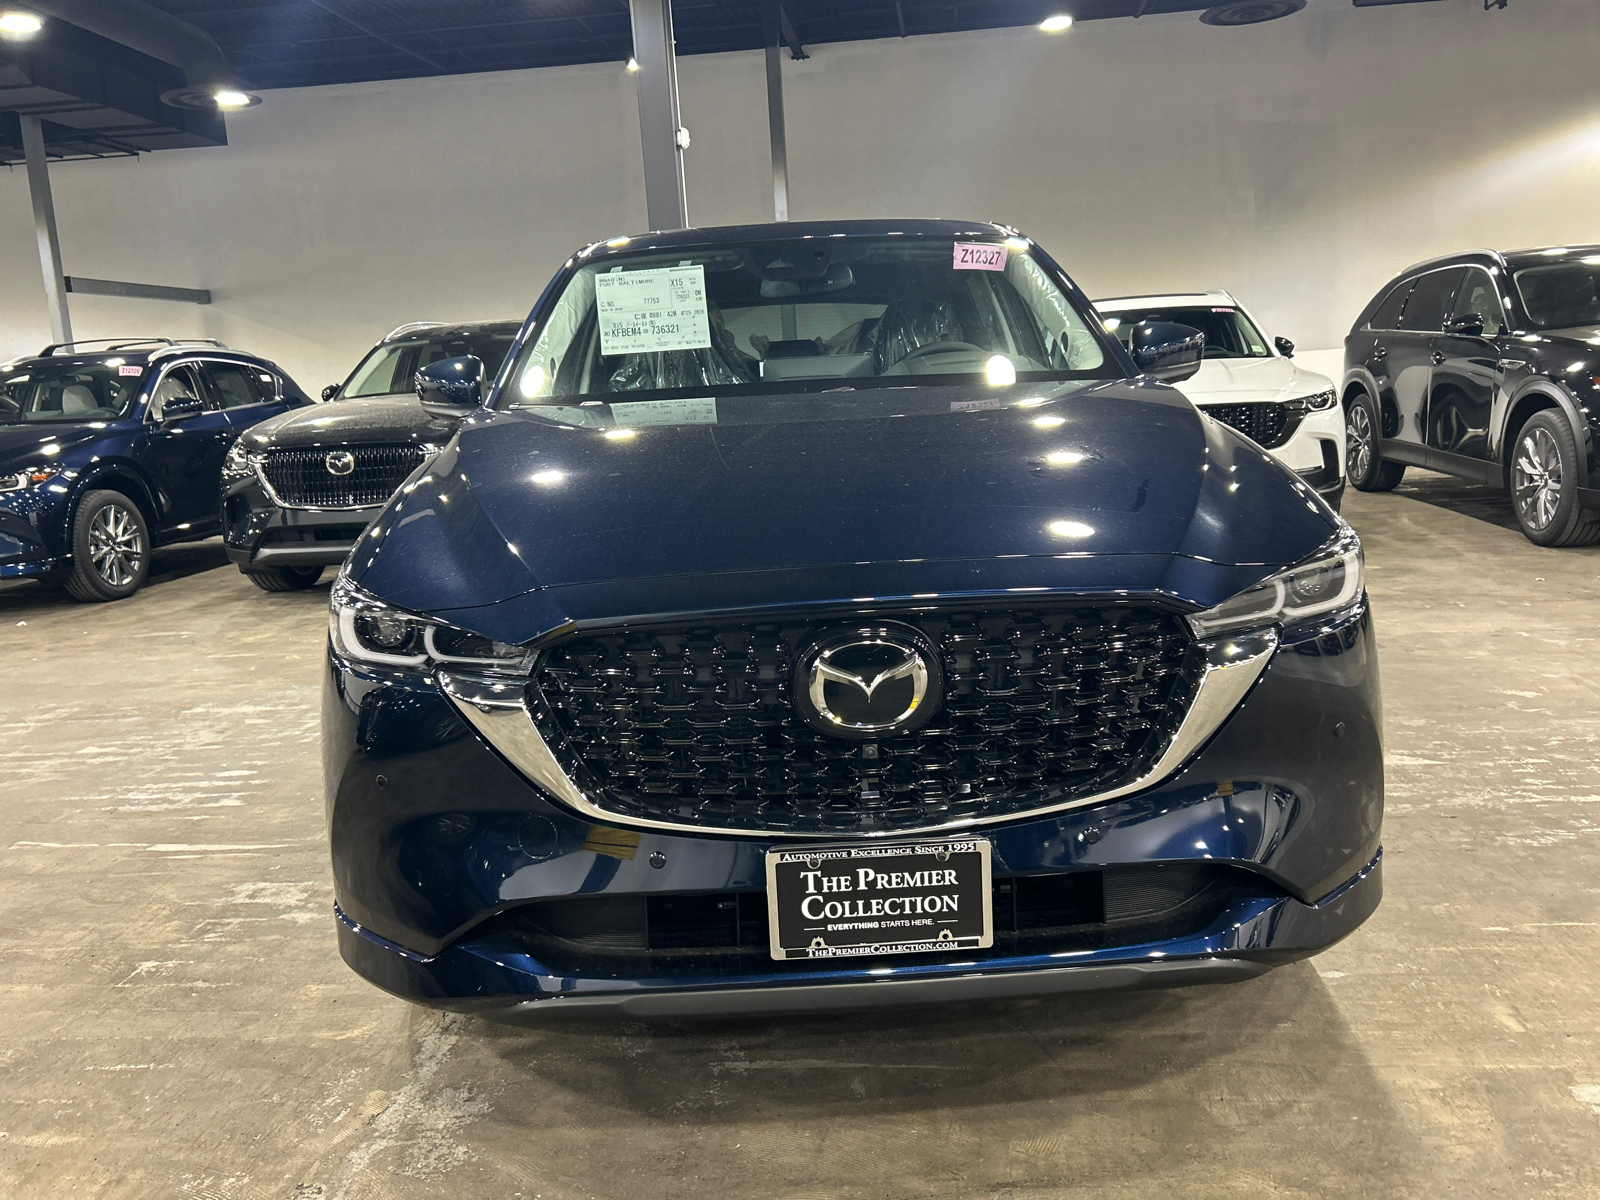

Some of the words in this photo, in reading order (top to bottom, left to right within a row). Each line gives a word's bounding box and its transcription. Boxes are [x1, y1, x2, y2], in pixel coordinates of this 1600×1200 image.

[960, 249, 1001, 266] Z12327
[670, 278, 683, 287] X15
[611, 327, 641, 338] KFBEM4
[651, 324, 679, 334] 736321
[783, 850, 848, 862] AUTOMOTIVE
[850, 848, 912, 858] EXCELLENCE
[914, 845, 945, 854] SINCE
[947, 843, 975, 852] 1995
[800, 870, 853, 894] THE
[856, 867, 959, 891] PREMIER
[801, 895, 959, 920] COLLECTION
[827, 922, 879, 931] EVERYTHING
[880, 920, 910, 928] STARTS
